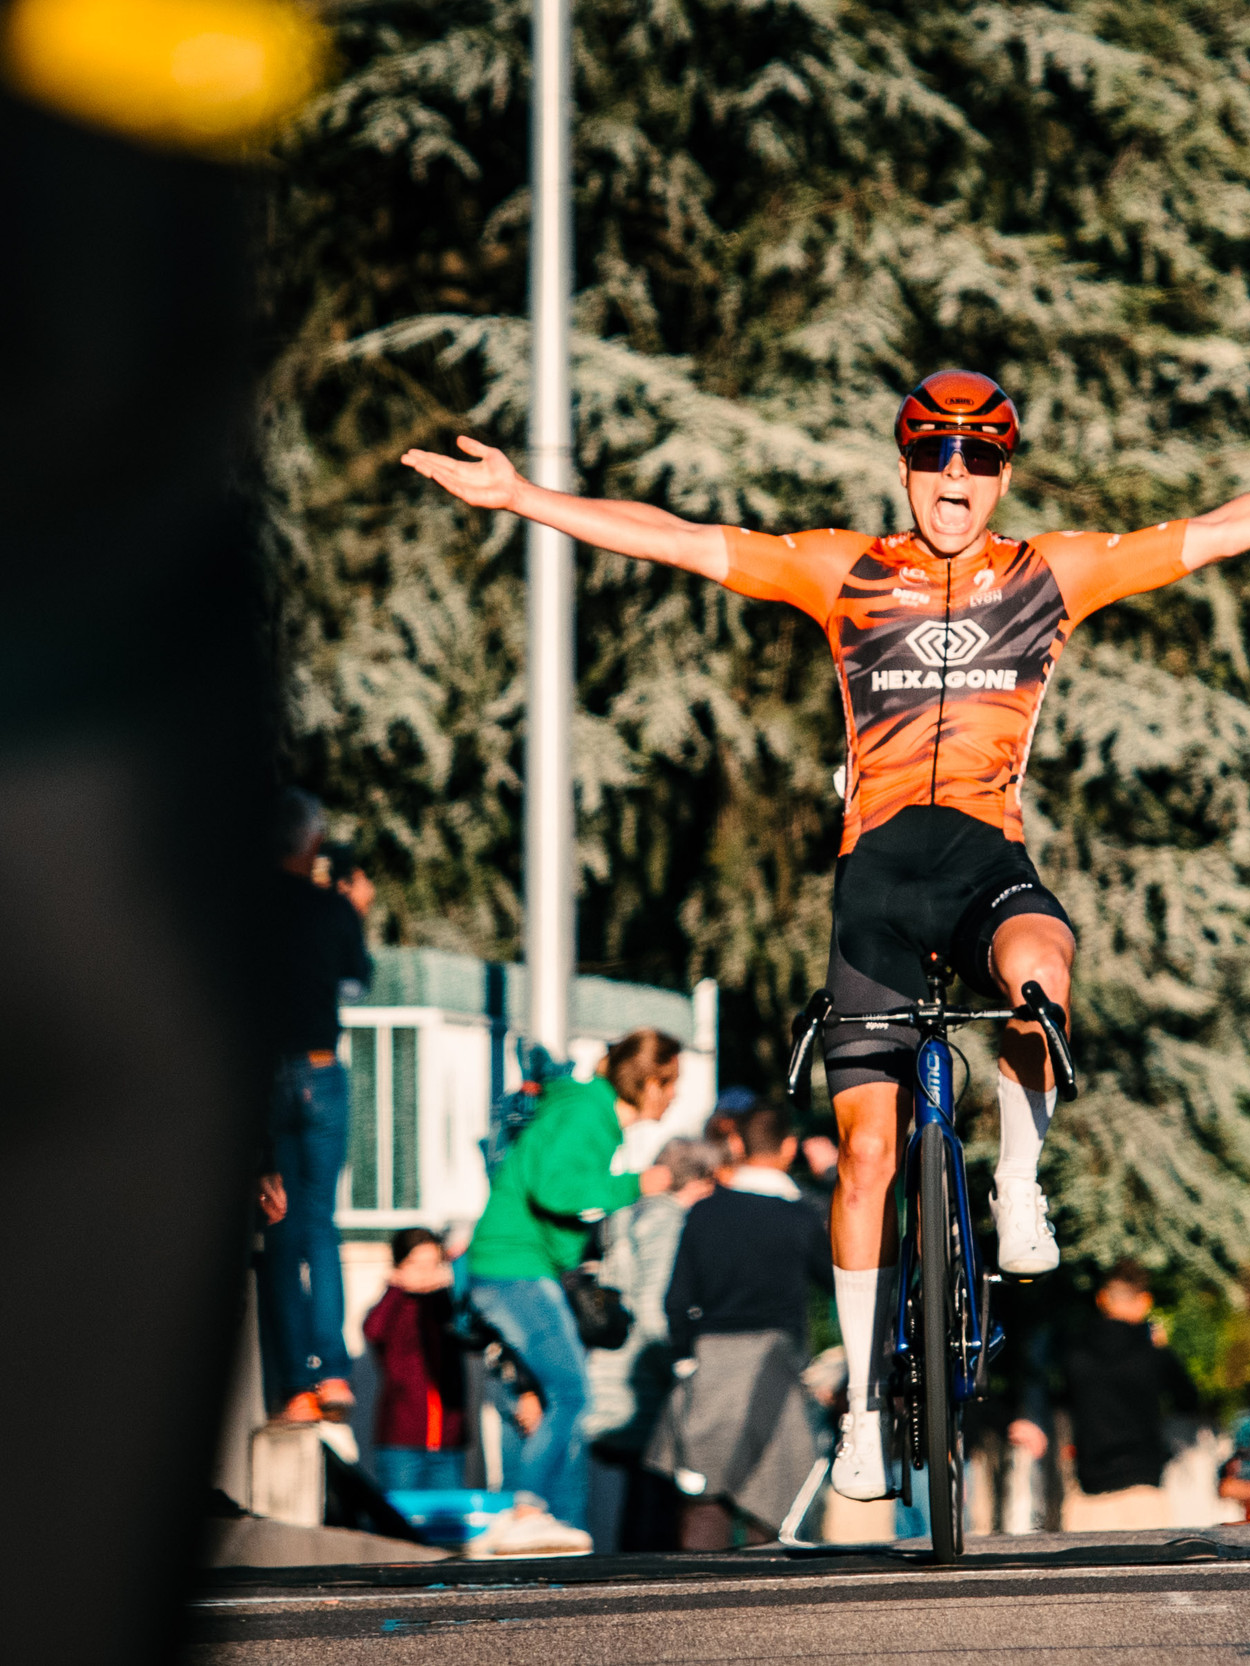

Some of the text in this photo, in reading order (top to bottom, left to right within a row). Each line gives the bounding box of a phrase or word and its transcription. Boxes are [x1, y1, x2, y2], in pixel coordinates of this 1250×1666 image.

[969, 588, 1003, 608] LYON
[871, 669, 1018, 692] HEXAGONE
[927, 1052, 941, 1108] BMC
